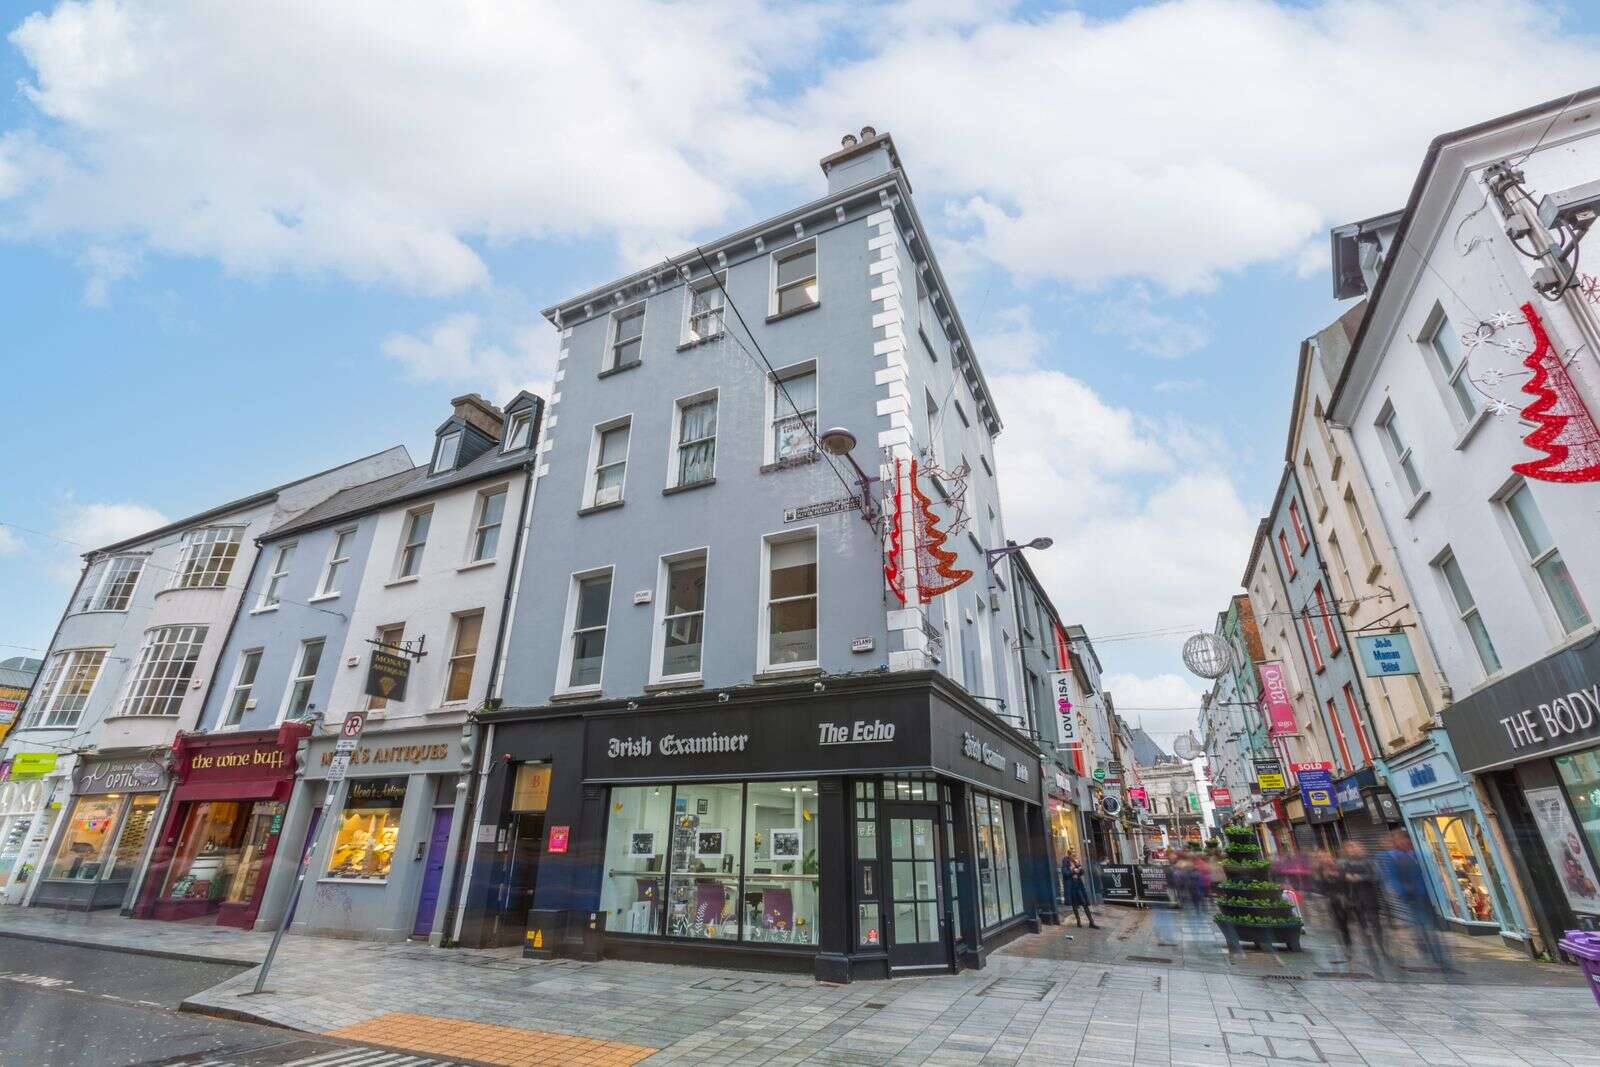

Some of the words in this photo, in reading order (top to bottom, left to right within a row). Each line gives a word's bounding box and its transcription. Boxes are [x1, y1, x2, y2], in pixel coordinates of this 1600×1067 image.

[1500, 709, 1544, 748] THE
[1538, 684, 1600, 738] BODY
[819, 723, 849, 742] The
[853, 720, 896, 740] Echo
[373, 743, 448, 765] ANTIQUES
[608, 736, 652, 758] Irish
[659, 731, 748, 755] Examiner
[192, 754, 213, 769] the
[216, 752, 250, 767] wine
[253, 749, 284, 768] buff
[1297, 762, 1322, 771] SOLD
